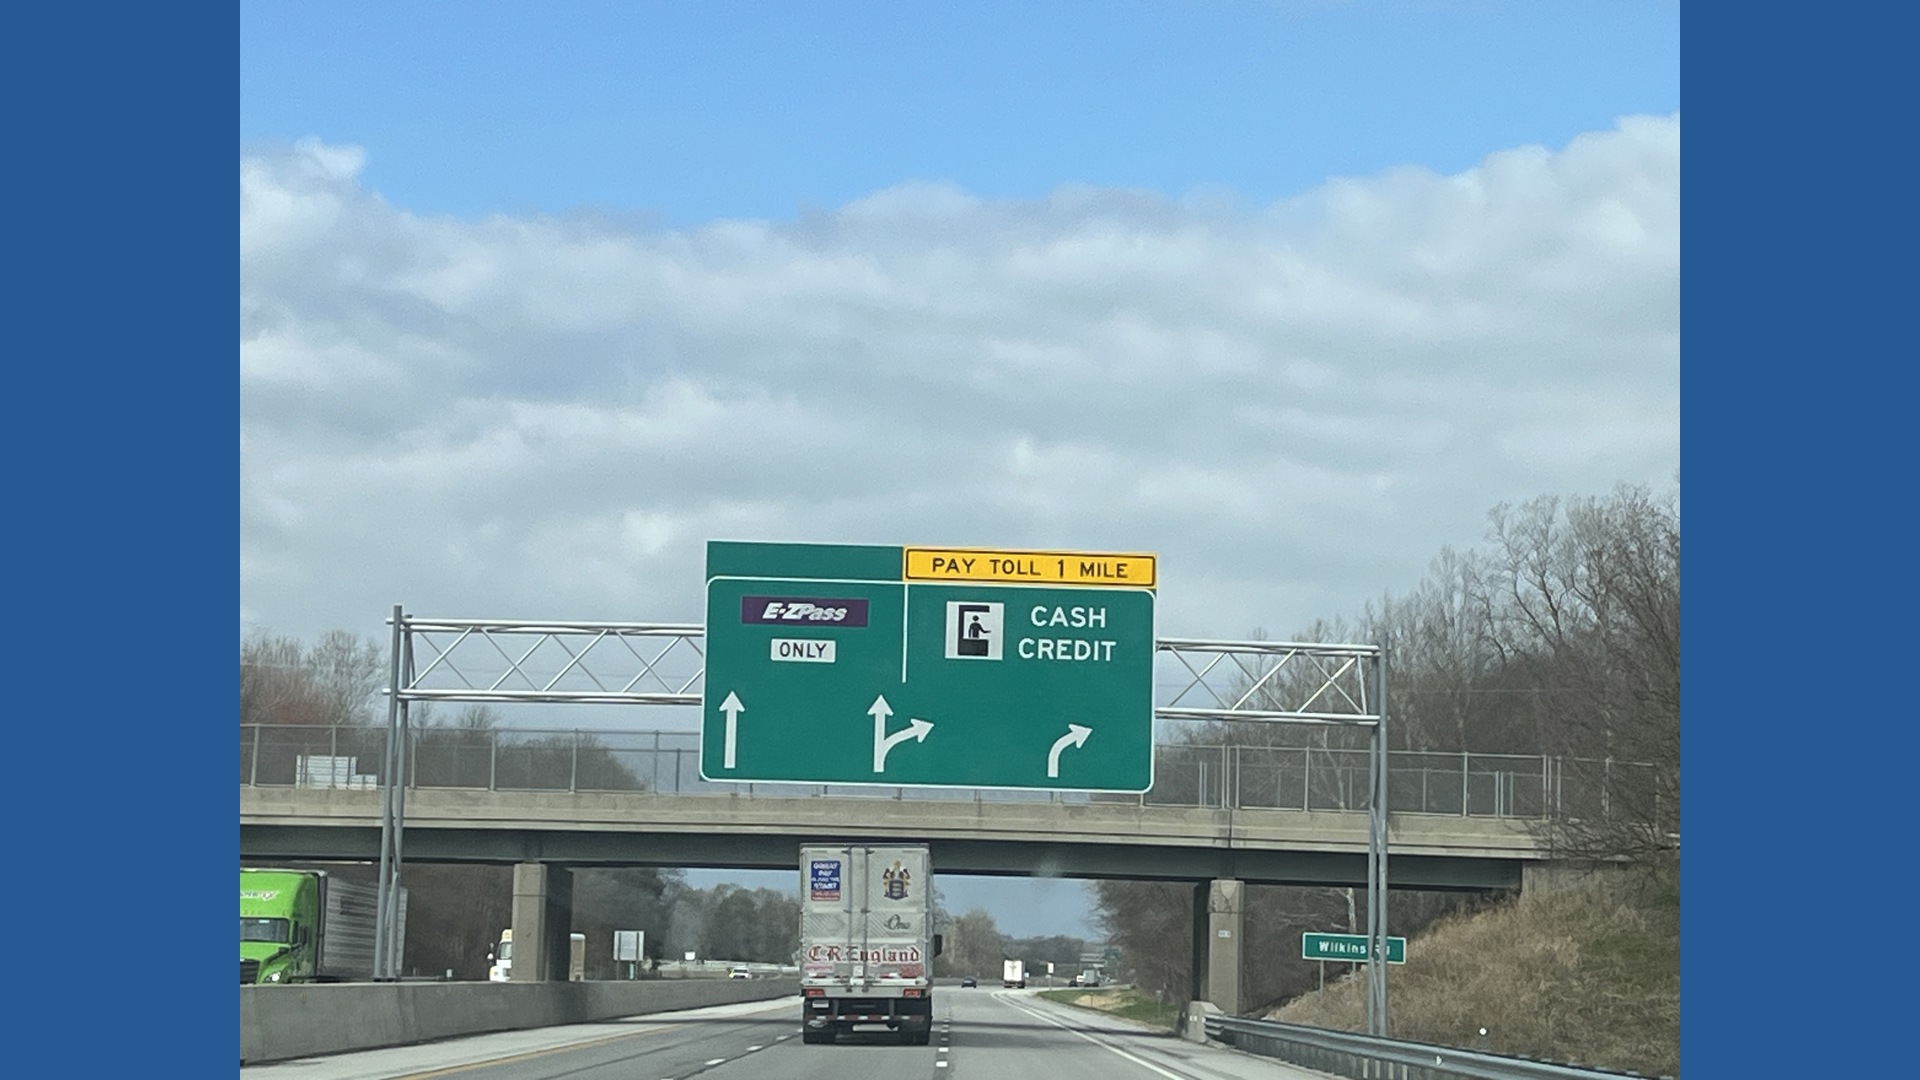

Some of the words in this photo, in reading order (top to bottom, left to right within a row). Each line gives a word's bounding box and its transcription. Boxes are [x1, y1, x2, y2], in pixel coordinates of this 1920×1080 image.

[932, 557, 976, 574] PAY
[990, 559, 1042, 576] TOLL
[1057, 560, 1065, 579] 1
[1079, 561, 1129, 579] MILE
[1030, 605, 1107, 628] CASH
[779, 641, 828, 659] ONLY
[1018, 638, 1117, 662] CREDIT
[1319, 941, 1367, 954] Wilkins
